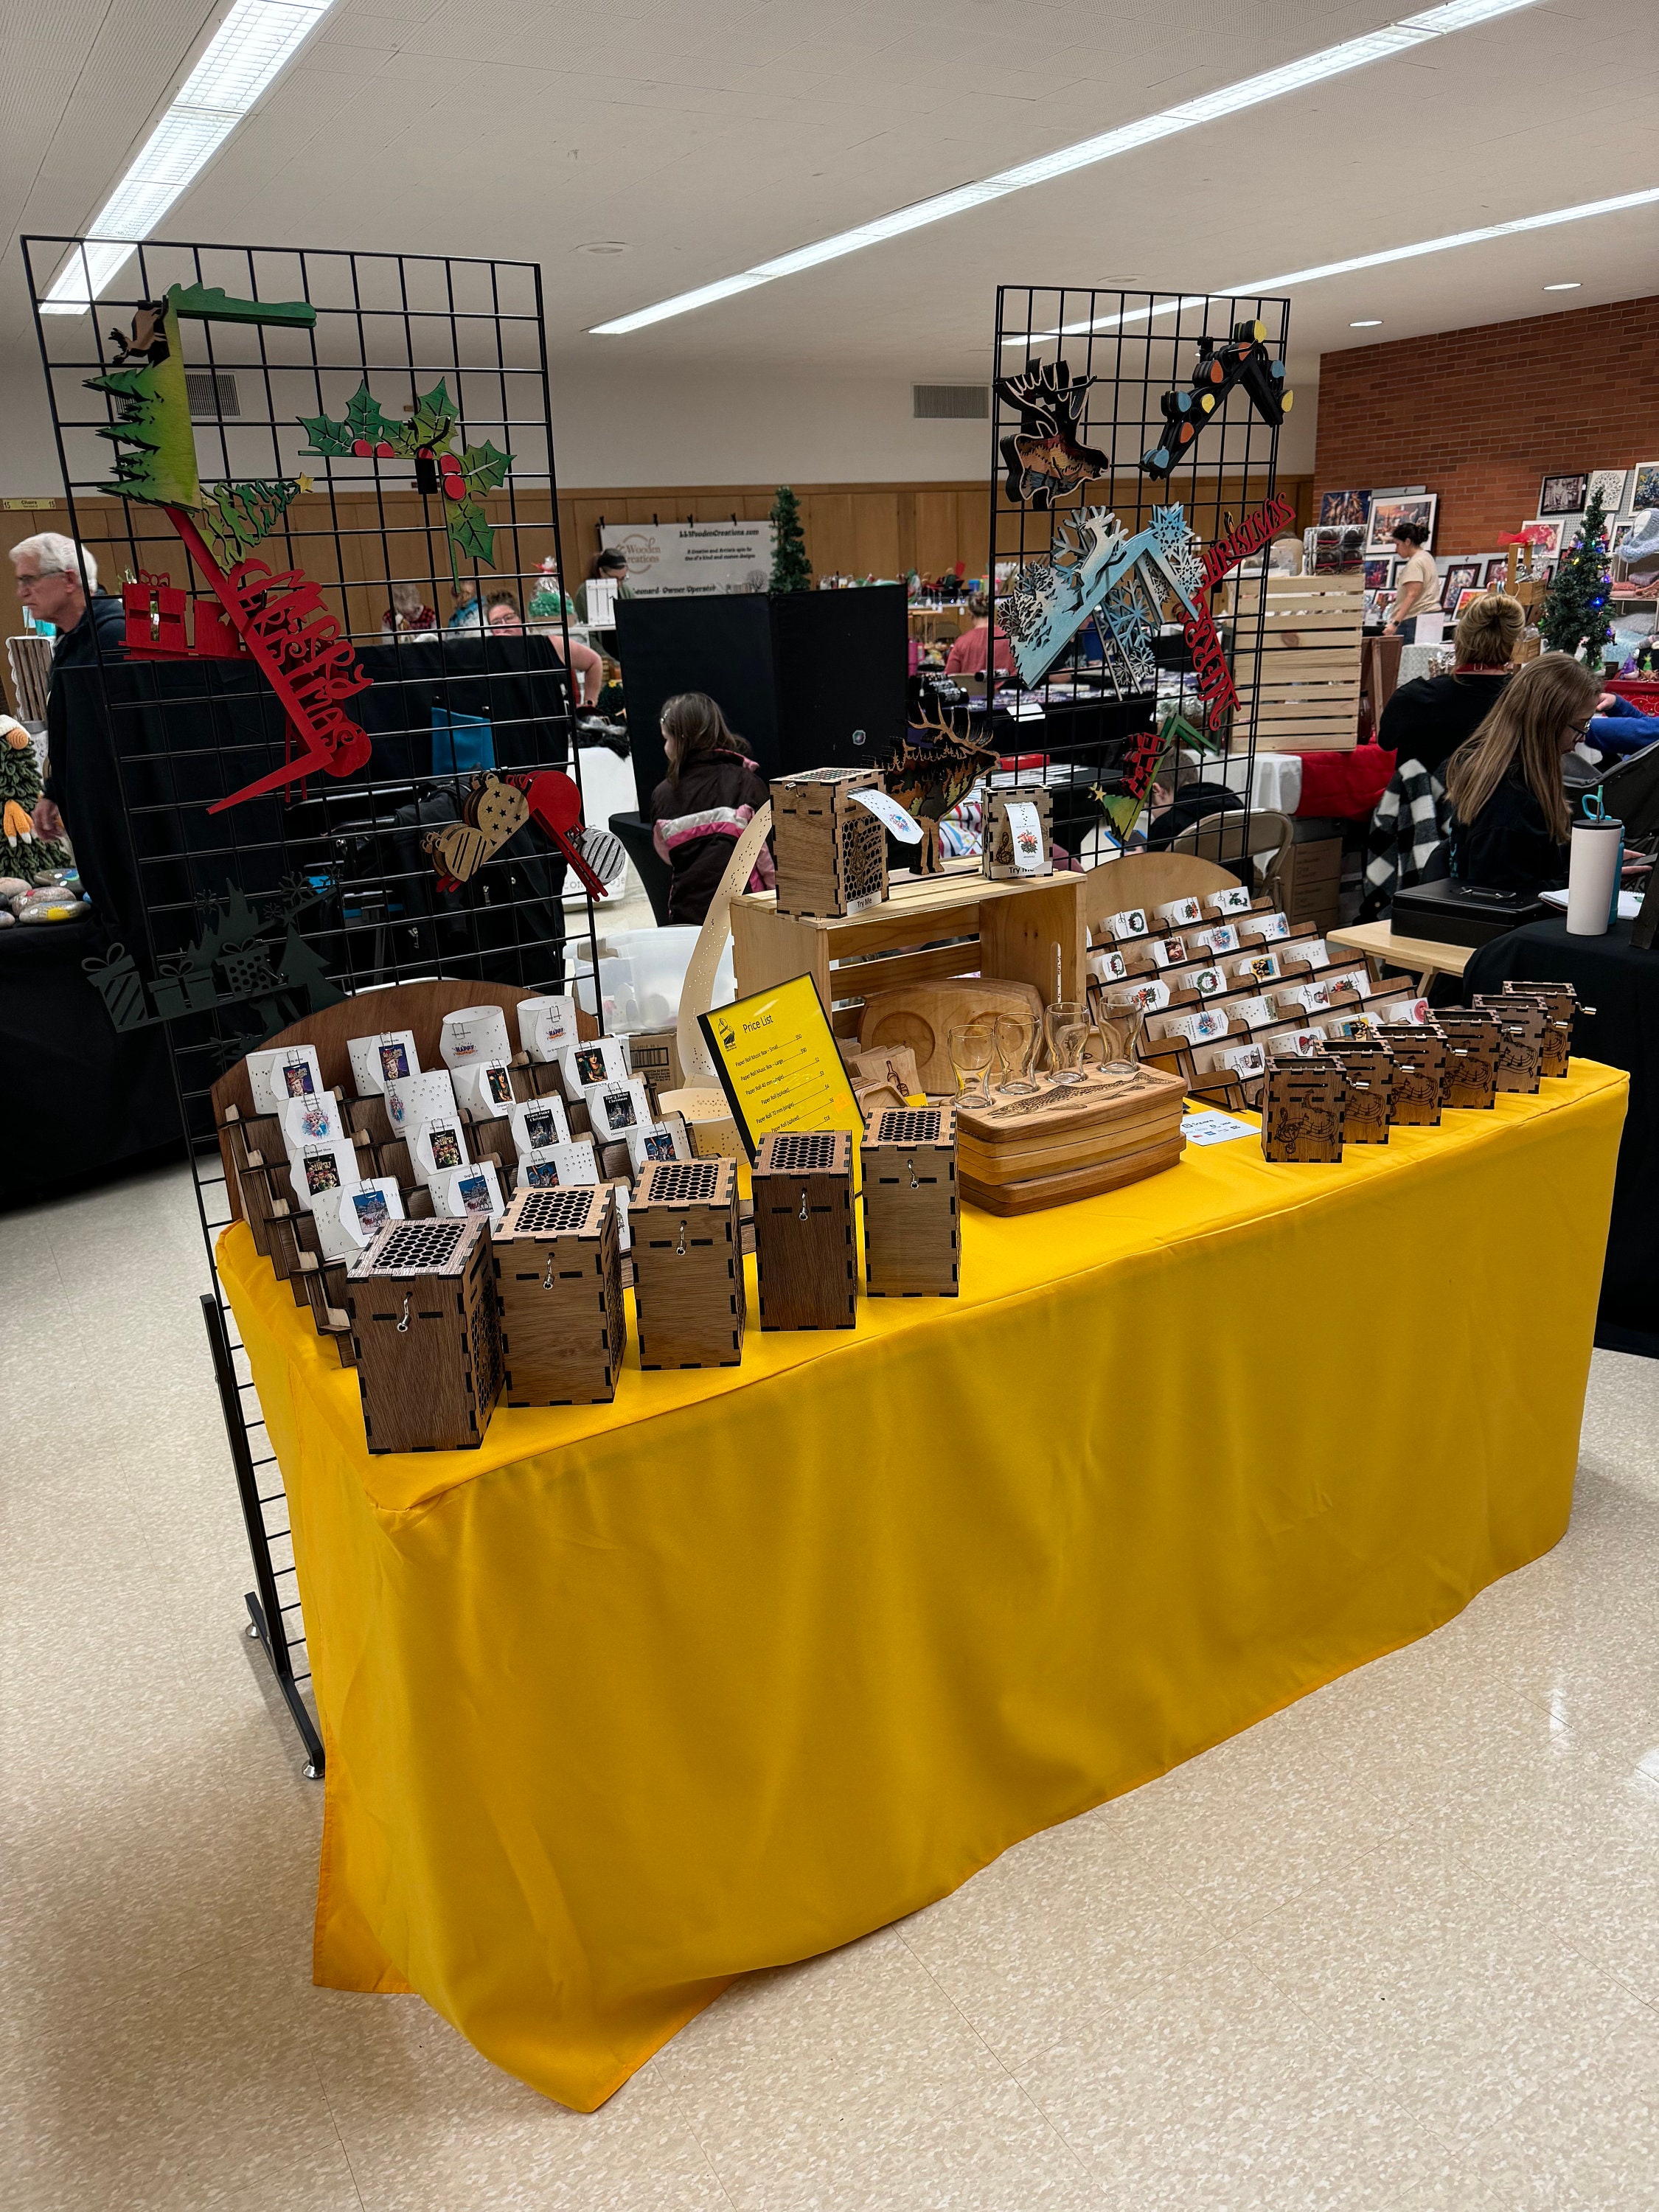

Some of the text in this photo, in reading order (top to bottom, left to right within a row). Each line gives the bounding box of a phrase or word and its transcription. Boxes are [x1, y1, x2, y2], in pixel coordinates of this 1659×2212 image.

[627, 537, 661, 553] Wooden
[627, 554, 659, 563] reations
[742, 1014, 773, 1034] Price List
[761, 1096, 771, 1105] Paper
[776, 1088, 790, 1097] (spliced)
[756, 1115, 766, 1124] Paper
[782, 1102, 794, 1110] (single)
[771, 1124, 782, 1133] Paper
[787, 1115, 800, 1125] (spliced)
